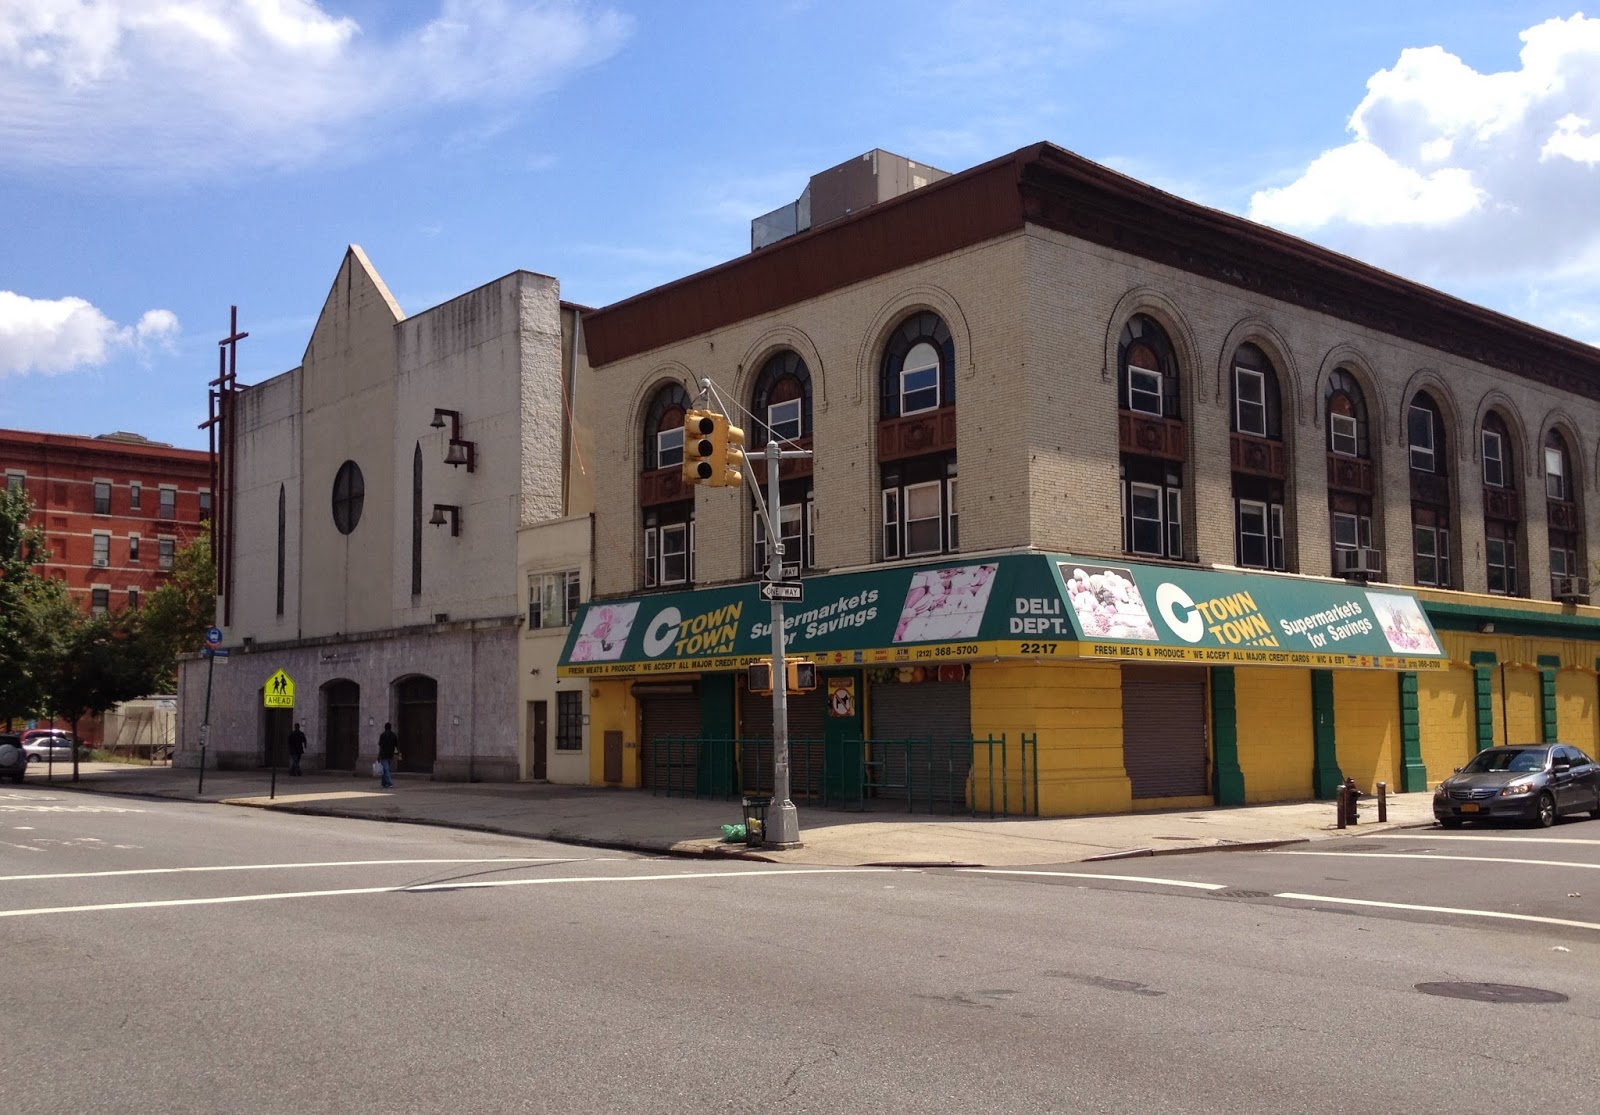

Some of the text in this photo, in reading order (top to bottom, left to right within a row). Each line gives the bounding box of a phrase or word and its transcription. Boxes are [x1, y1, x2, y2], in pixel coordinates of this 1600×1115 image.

[784, 568, 796, 576] WAY
[766, 587, 798, 596] ONE WAY
[750, 589, 879, 639] Suermarkets
[1015, 598, 1060, 614] DELI
[1156, 582, 1258, 643] C TOWN
[805, 607, 878, 639] Savings
[1009, 617, 1067, 634] DEPT.
[1279, 600, 1363, 636] Supermarkets
[643, 600, 743, 657] C TOWN
[1208, 613, 1272, 645] TOWN
[1307, 617, 1373, 649] for Savings
[674, 621, 739, 656] TOWN
[916, 650, 932, 659] (212)
[935, 645, 978, 656] 368-5700
[1020, 643, 1057, 654] 2217
[1094, 645, 1345, 664] FRESH MEATS & PRODUCE WE ACCEPT ALL MAJOR CREDIT CARDS WIC & EBT
[568, 666, 584, 675] FRESH
[586, 666, 603, 674] MEATS
[605, 665, 609, 673] &
[611, 664, 636, 672] PRODUCE
[643, 663, 652, 671] WE
[654, 662, 677, 670] ACCEPT
[679, 661, 689, 669] ALL
[692, 659, 712, 668] MAJOR
[715, 658, 737, 667] CREDIT
[267, 696, 291, 705] AHEAD
